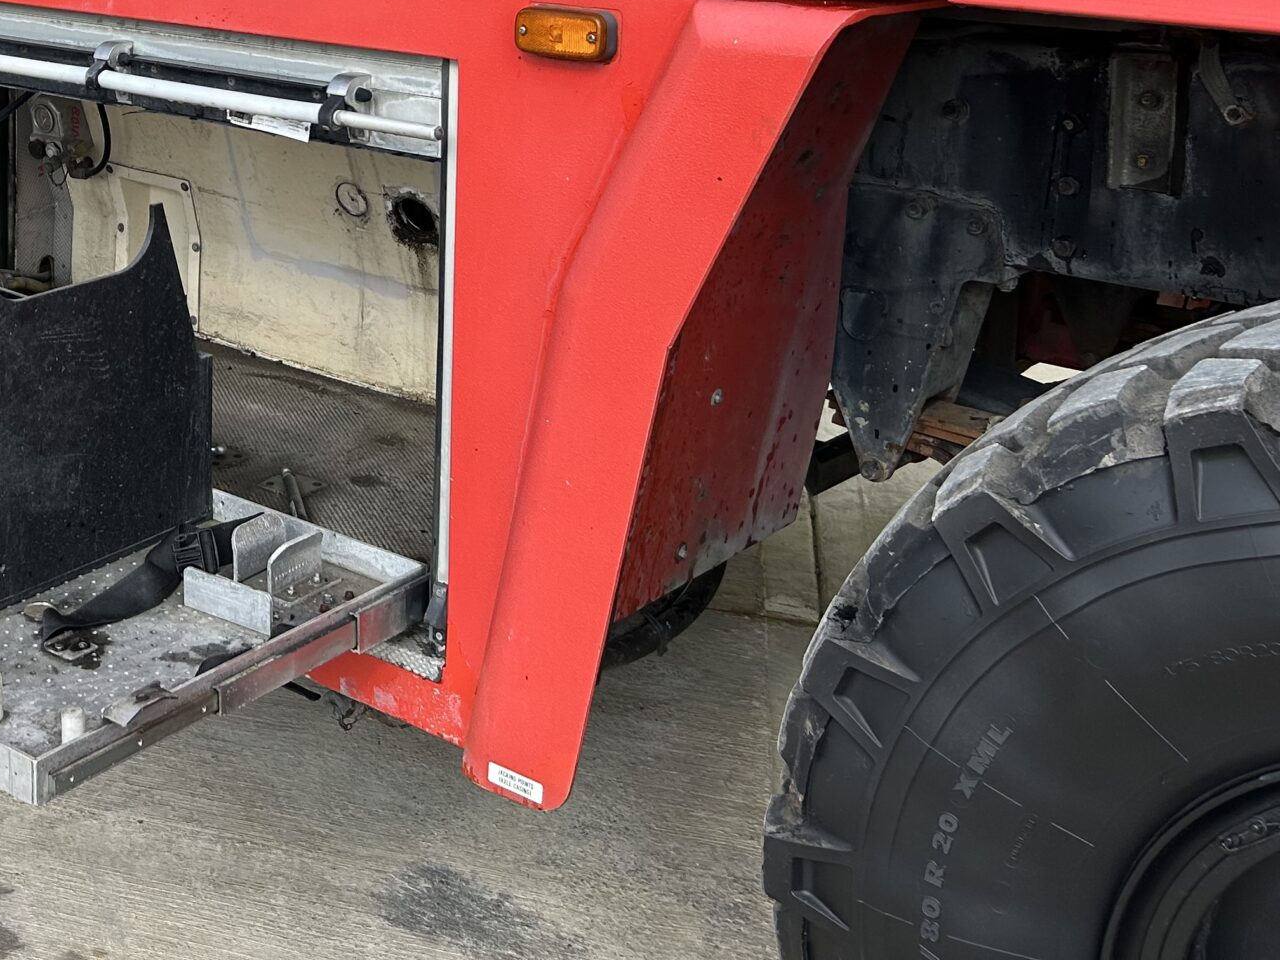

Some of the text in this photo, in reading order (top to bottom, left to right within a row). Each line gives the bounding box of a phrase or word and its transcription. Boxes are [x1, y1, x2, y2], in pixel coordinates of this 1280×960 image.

[952, 724, 1014, 800] XML
[931, 811, 959, 855] 20
[923, 860, 945, 888] R
